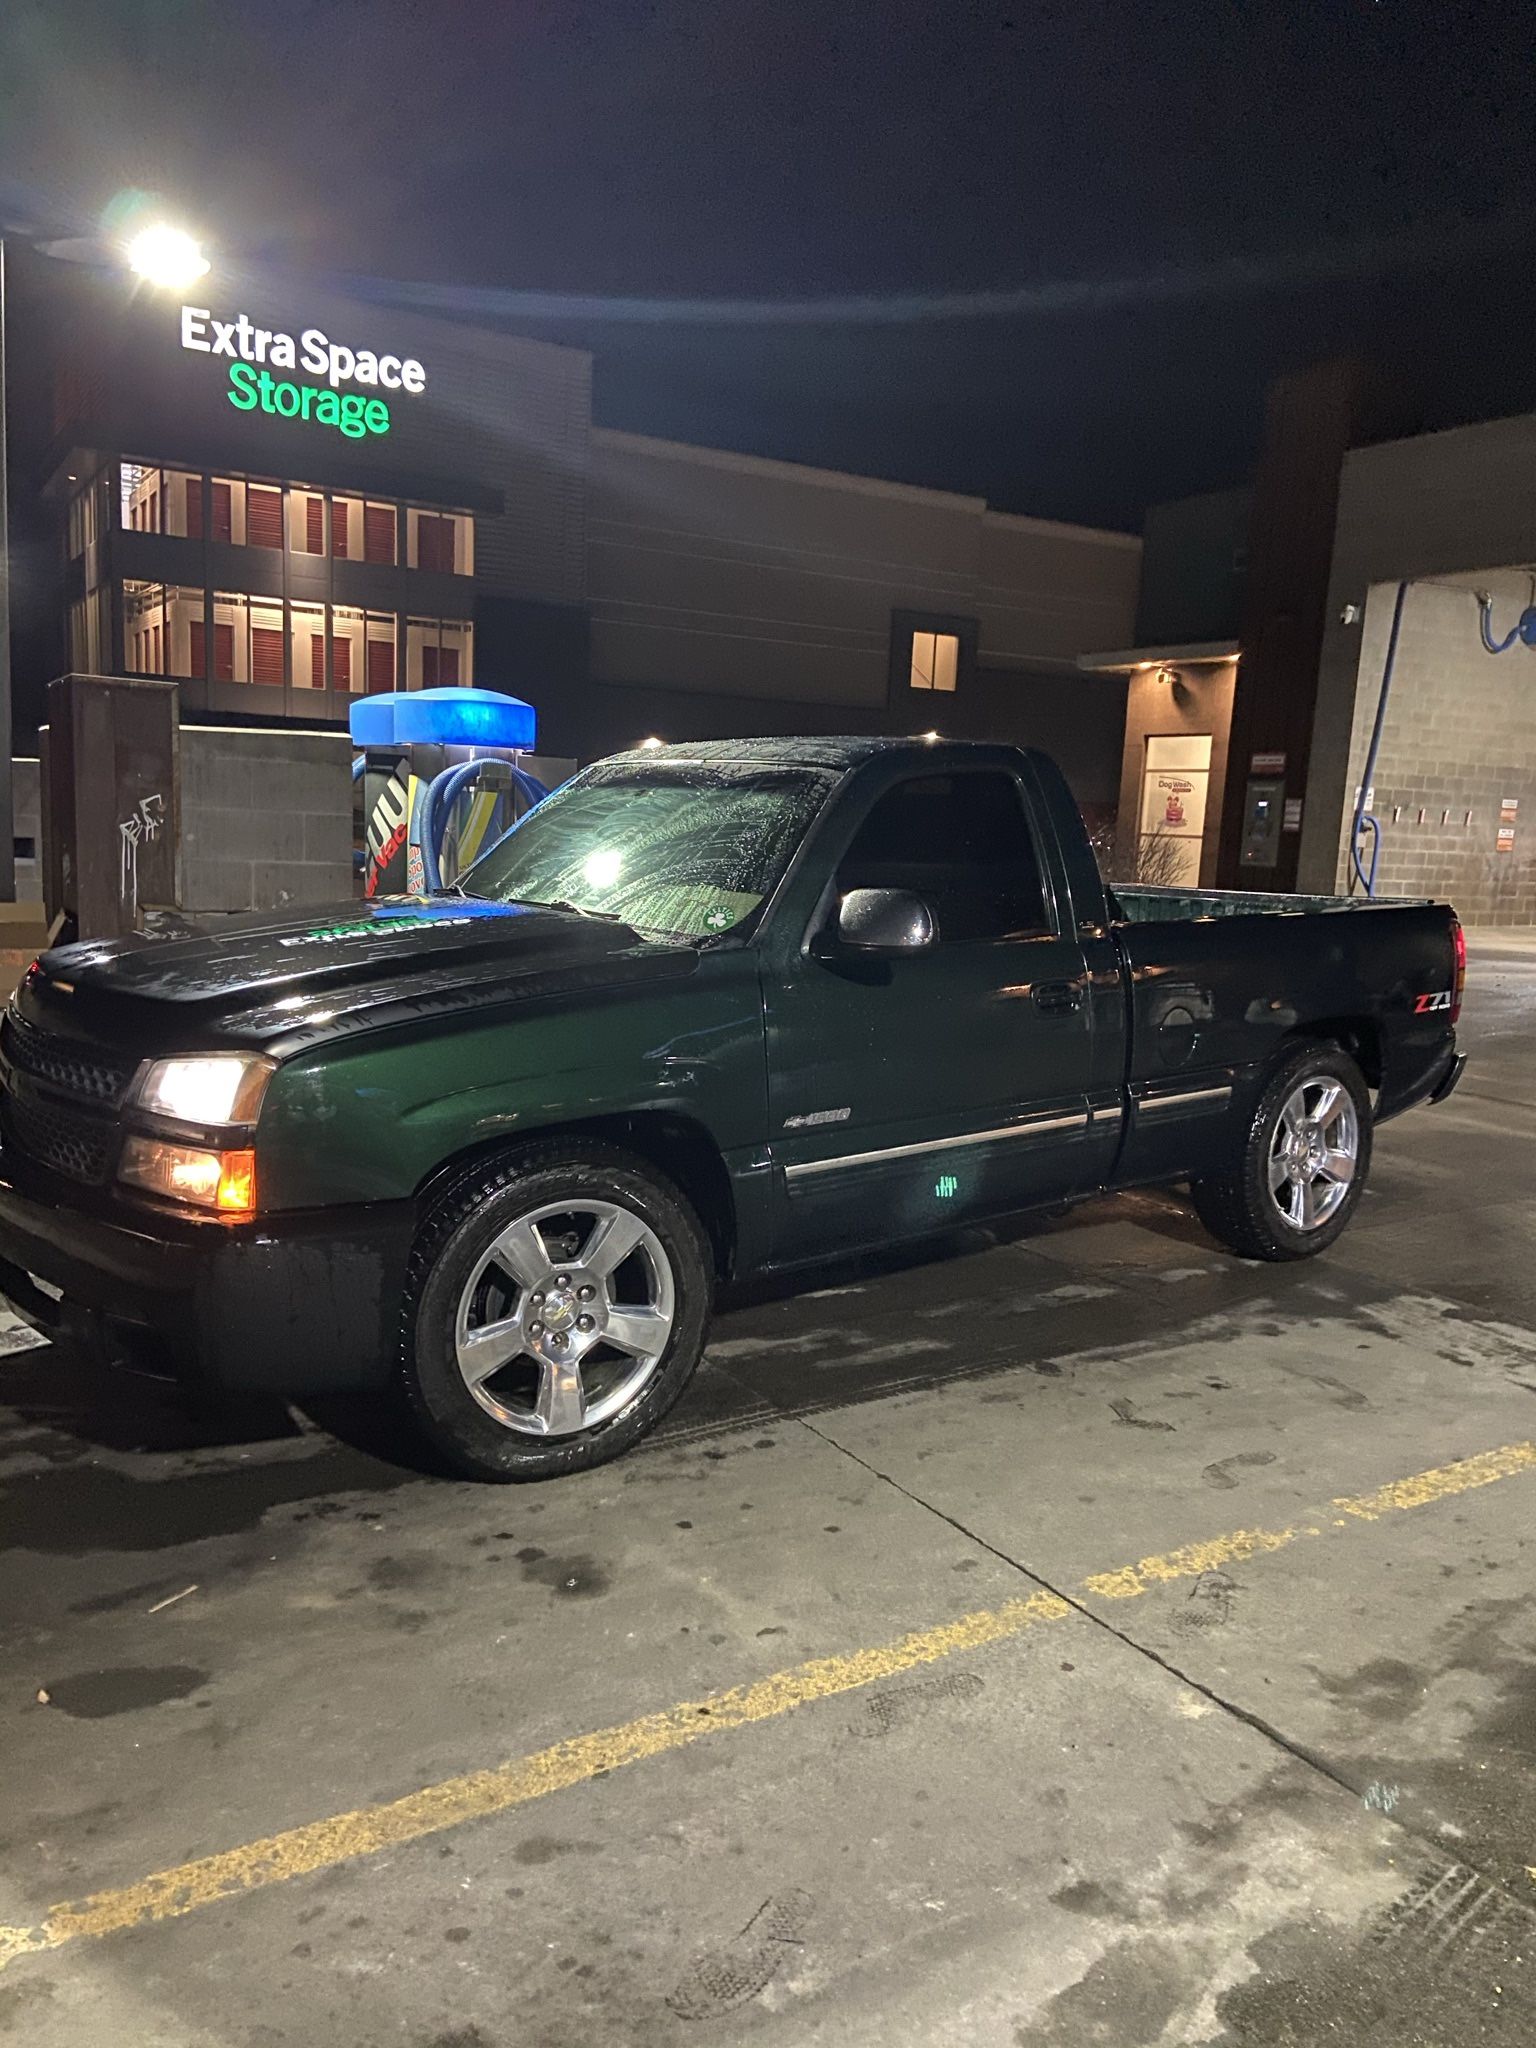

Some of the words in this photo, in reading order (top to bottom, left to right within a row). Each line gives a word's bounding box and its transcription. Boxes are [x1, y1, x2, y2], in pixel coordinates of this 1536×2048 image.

[181, 305, 296, 369] Extra
[300, 328, 426, 393] Space
[227, 362, 390, 438] Storage
[1158, 780, 1172, 789] Dog
[1172, 780, 1192, 788] Wash
[1414, 990, 1451, 1014] Z71
